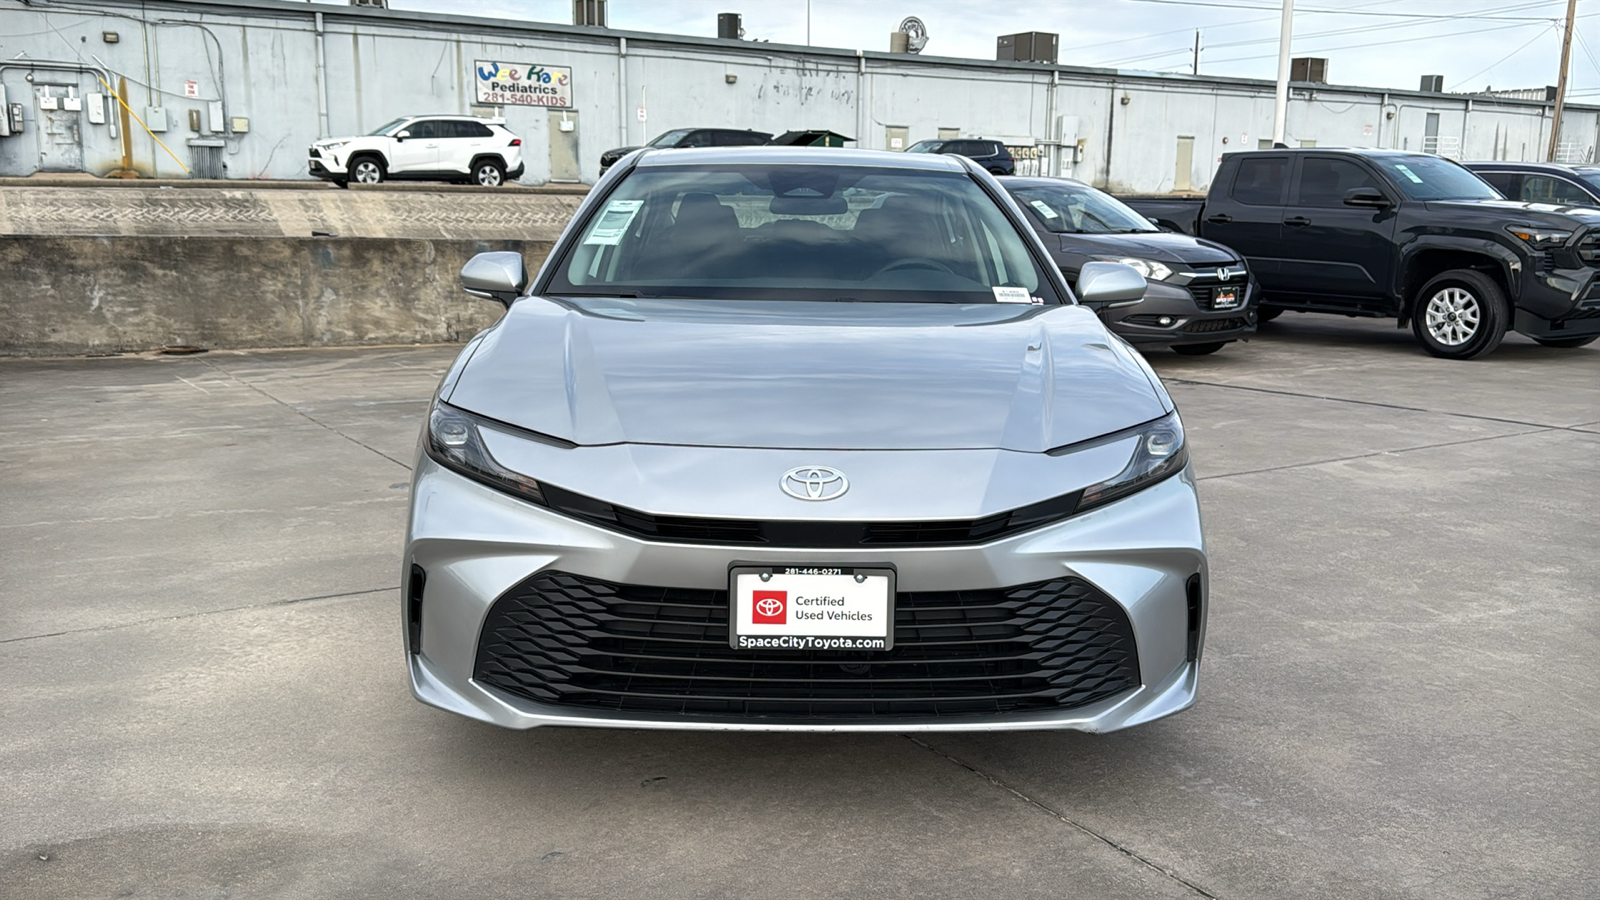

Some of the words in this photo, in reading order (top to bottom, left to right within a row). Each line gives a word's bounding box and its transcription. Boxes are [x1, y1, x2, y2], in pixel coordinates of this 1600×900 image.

[478, 62, 522, 81] Wee
[527, 65, 569, 86] Kare
[491, 82, 558, 95] Pediatrics
[483, 92, 567, 106] 281-540-KIDS
[795, 596, 845, 606] Certified
[795, 610, 824, 620] Used
[826, 611, 873, 621] Vehicles
[739, 636, 885, 649] SpaceCityToyota.com
